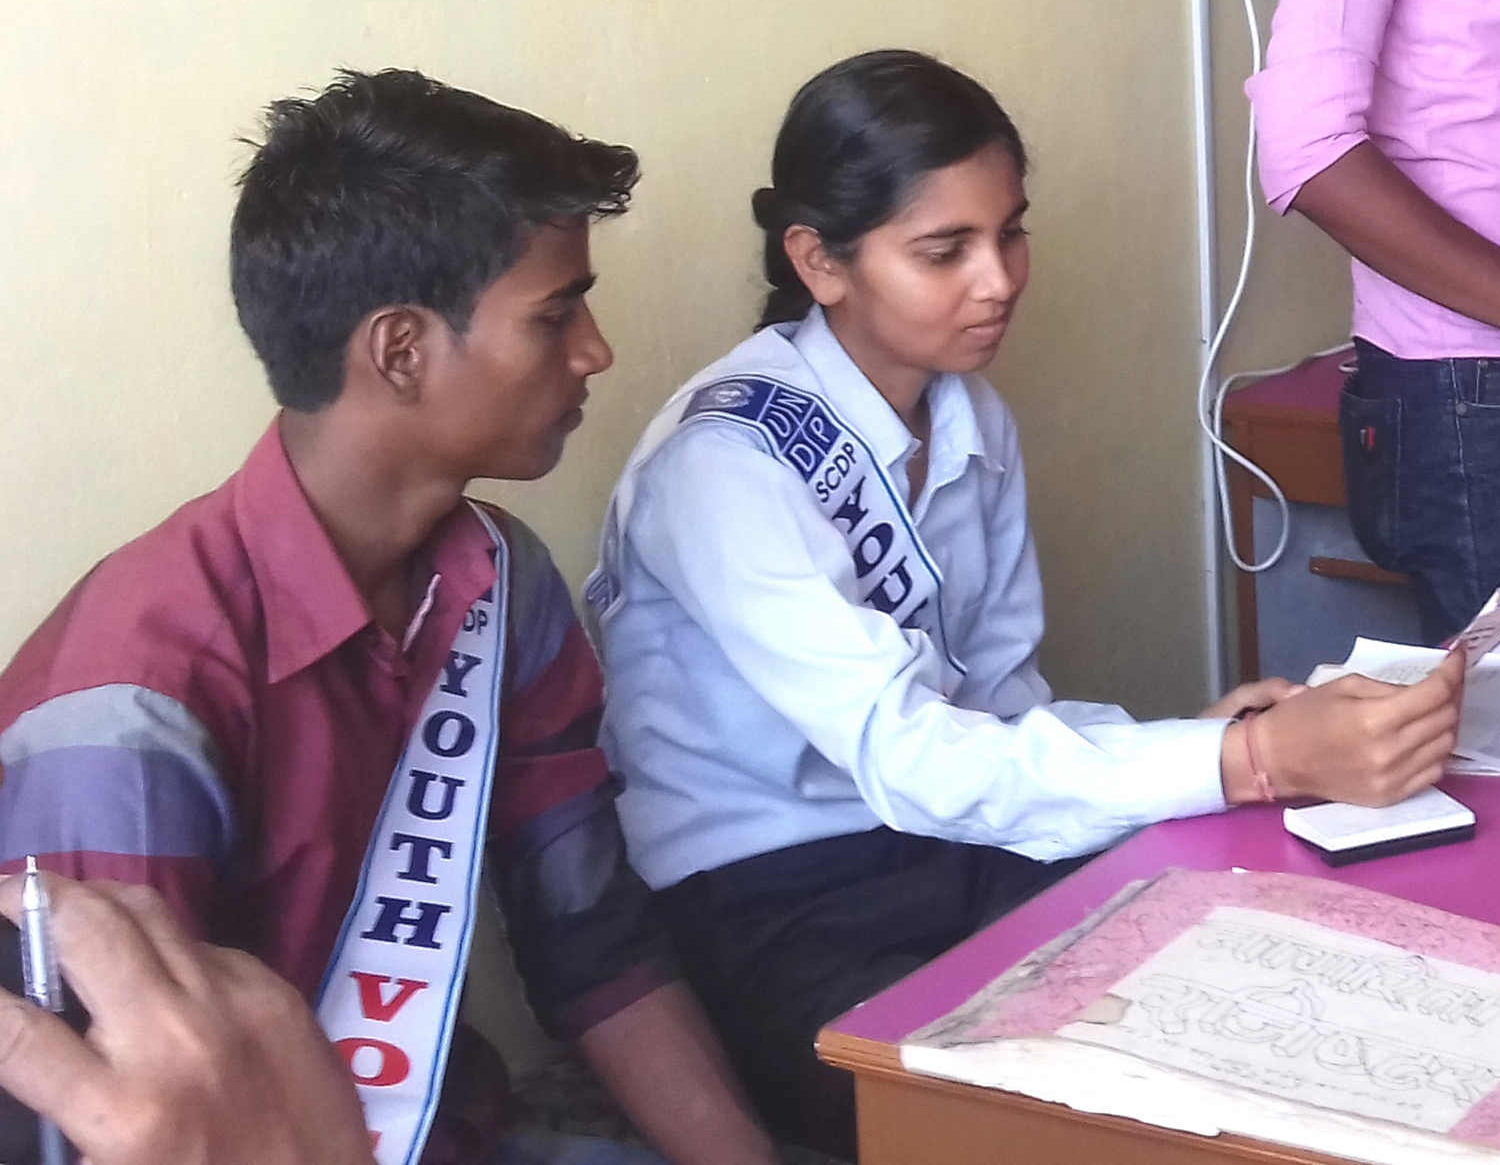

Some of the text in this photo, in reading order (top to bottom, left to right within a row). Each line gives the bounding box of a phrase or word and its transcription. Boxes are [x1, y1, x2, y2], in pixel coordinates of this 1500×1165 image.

[815, 441, 858, 504] SCDP
[360, 649, 483, 950] YOUTH
[334, 972, 428, 1154] VO
